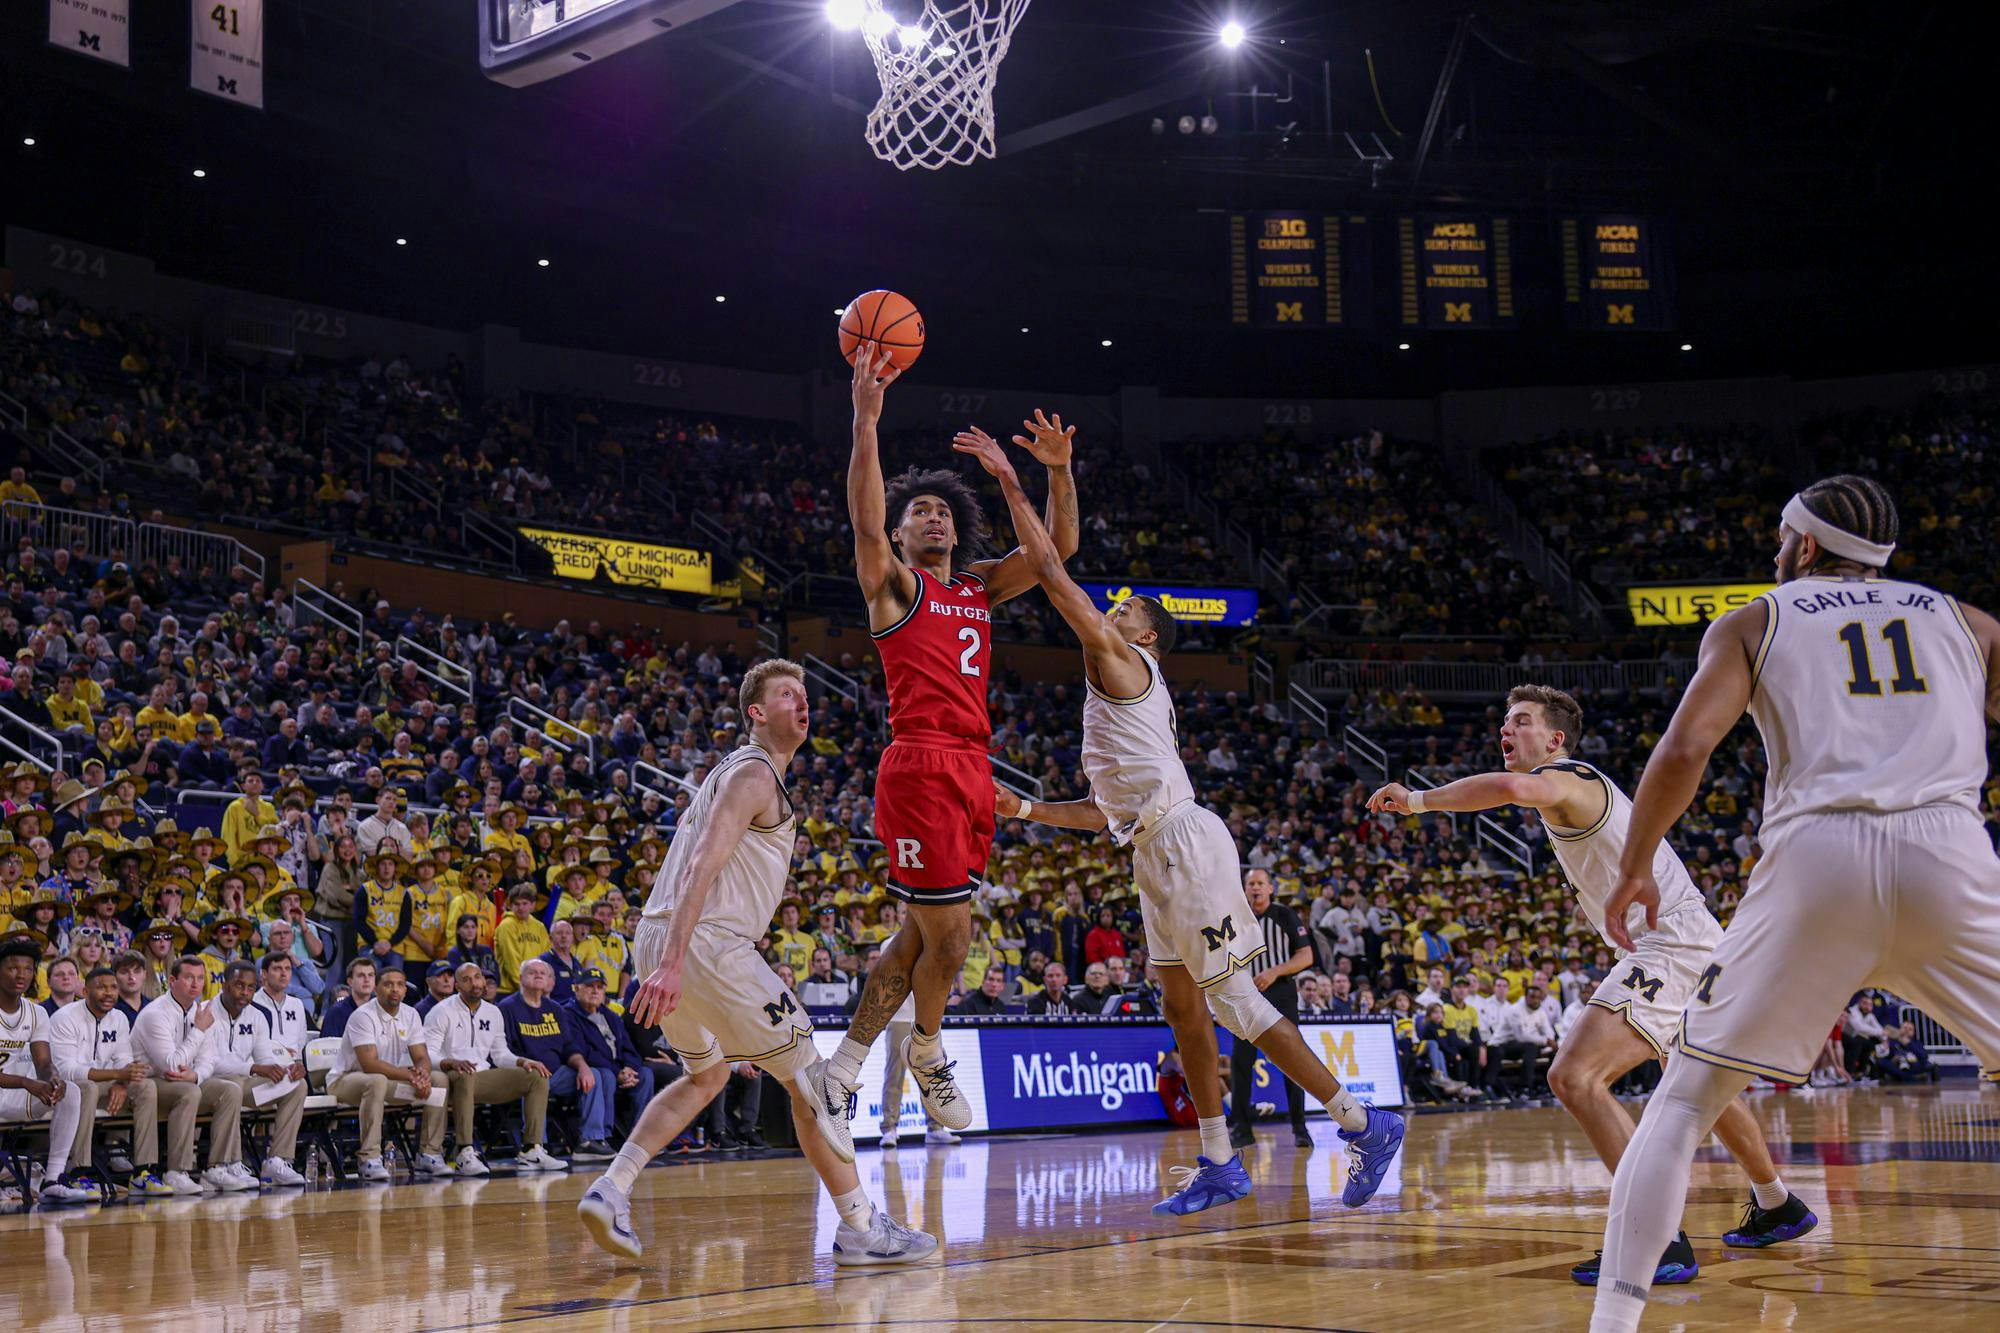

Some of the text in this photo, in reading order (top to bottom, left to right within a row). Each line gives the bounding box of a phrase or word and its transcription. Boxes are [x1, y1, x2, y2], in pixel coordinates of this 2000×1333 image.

[211, 4, 240, 36] 41
[79, 30, 100, 51] M
[217, 75, 237, 94] M
[48, 242, 108, 280] 224
[1275, 302, 1304, 322] M
[1444, 302, 1472, 322] M
[1606, 304, 1635, 325] M
[293, 308, 347, 340] 225
[632, 363, 683, 389] 226
[1590, 389, 1642, 411] 229
[1263, 405, 1313, 425] 228
[616, 545, 634, 559] OF
[627, 560, 674, 579] UNION
[1793, 590, 1937, 614] GAYLE JR.
[958, 627, 982, 677] 2
[1837, 617, 1929, 698] 11
[895, 838, 925, 869] R
[370, 896, 383, 906] M
[374, 909, 396, 927] 24
[420, 912, 441, 929] 24
[1200, 915, 1237, 952] M
[590, 969, 601, 977] M
[1622, 966, 1664, 1003] M
[285, 1010, 296, 1020] M
[542, 1013, 556, 1022] M
[764, 991, 797, 1026] M
[238, 1024, 253, 1035] M
[479, 1019, 490, 1031] M
[519, 1022, 561, 1037] MICHIGAN
[102, 1030, 117, 1043] M
[1320, 1031, 1360, 1077] M
